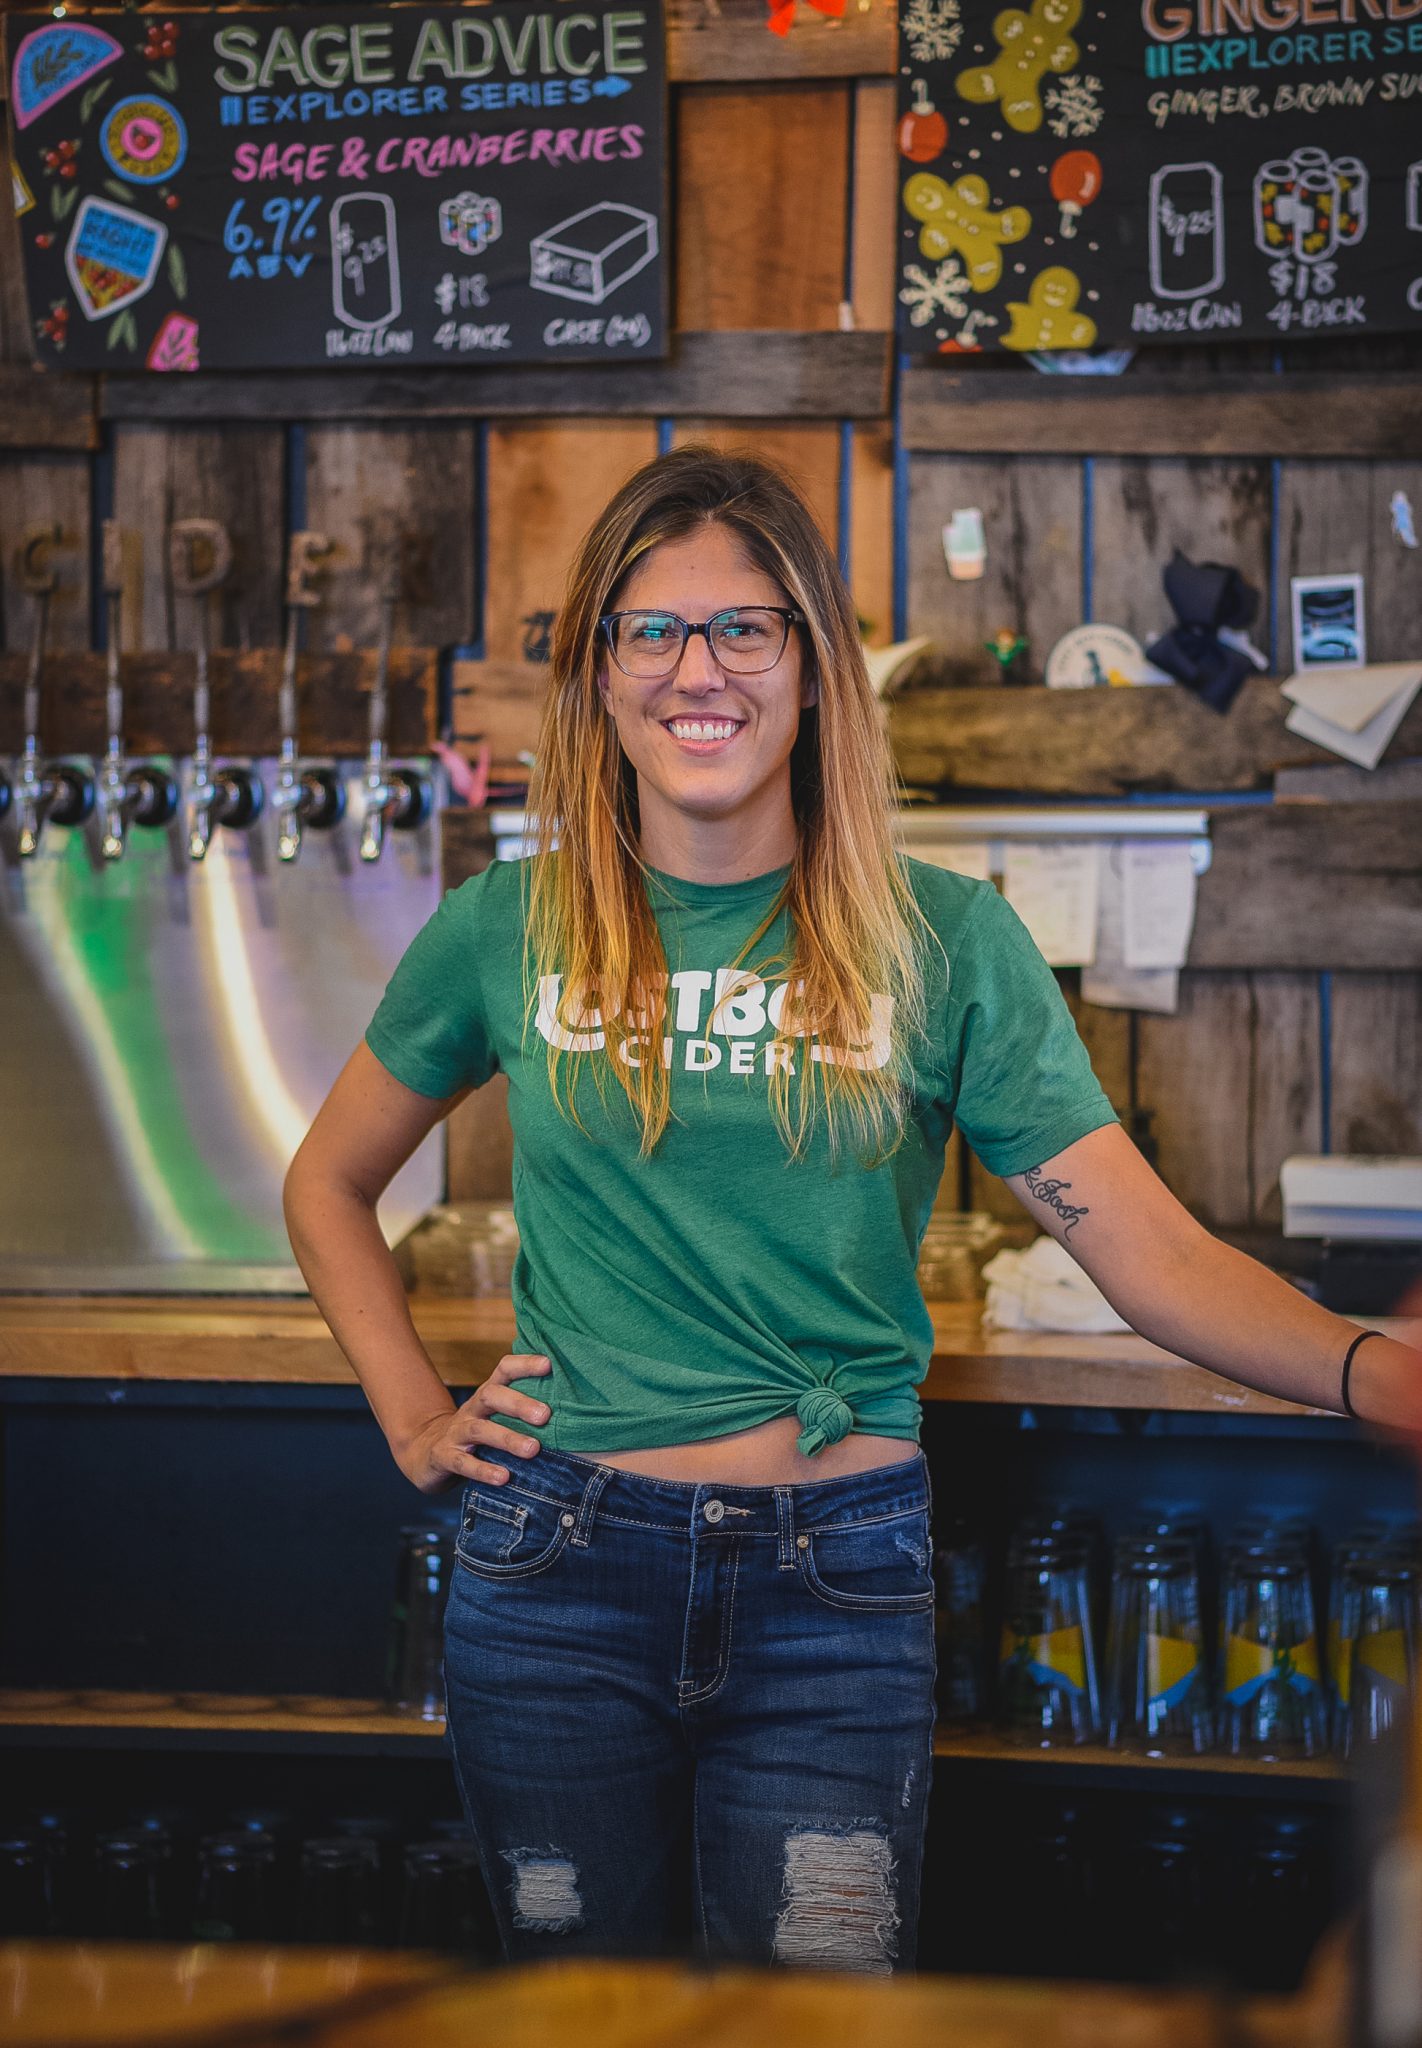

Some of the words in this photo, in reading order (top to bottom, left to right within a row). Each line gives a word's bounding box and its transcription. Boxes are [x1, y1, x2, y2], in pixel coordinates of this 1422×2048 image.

[213, 23, 395, 94] SAGE
[406, 10, 649, 83] ADVICE
[1172, 28, 1376, 77] EXPLORER
[247, 85, 449, 127] EXPLORER
[460, 77, 591, 112] SERIES
[1273, 76, 1375, 114] BROWN
[1379, 71, 1422, 102] SU
[231, 141, 336, 185] SAGE
[337, 136, 371, 180] &
[375, 123, 646, 178] CRANBERRIES
[223, 194, 323, 254] 6.9%
[227, 252, 315, 280] ABV
[1267, 260, 1339, 300] $18
[434, 272, 491, 316] $18
[618, 1034, 796, 1076] CIDER
